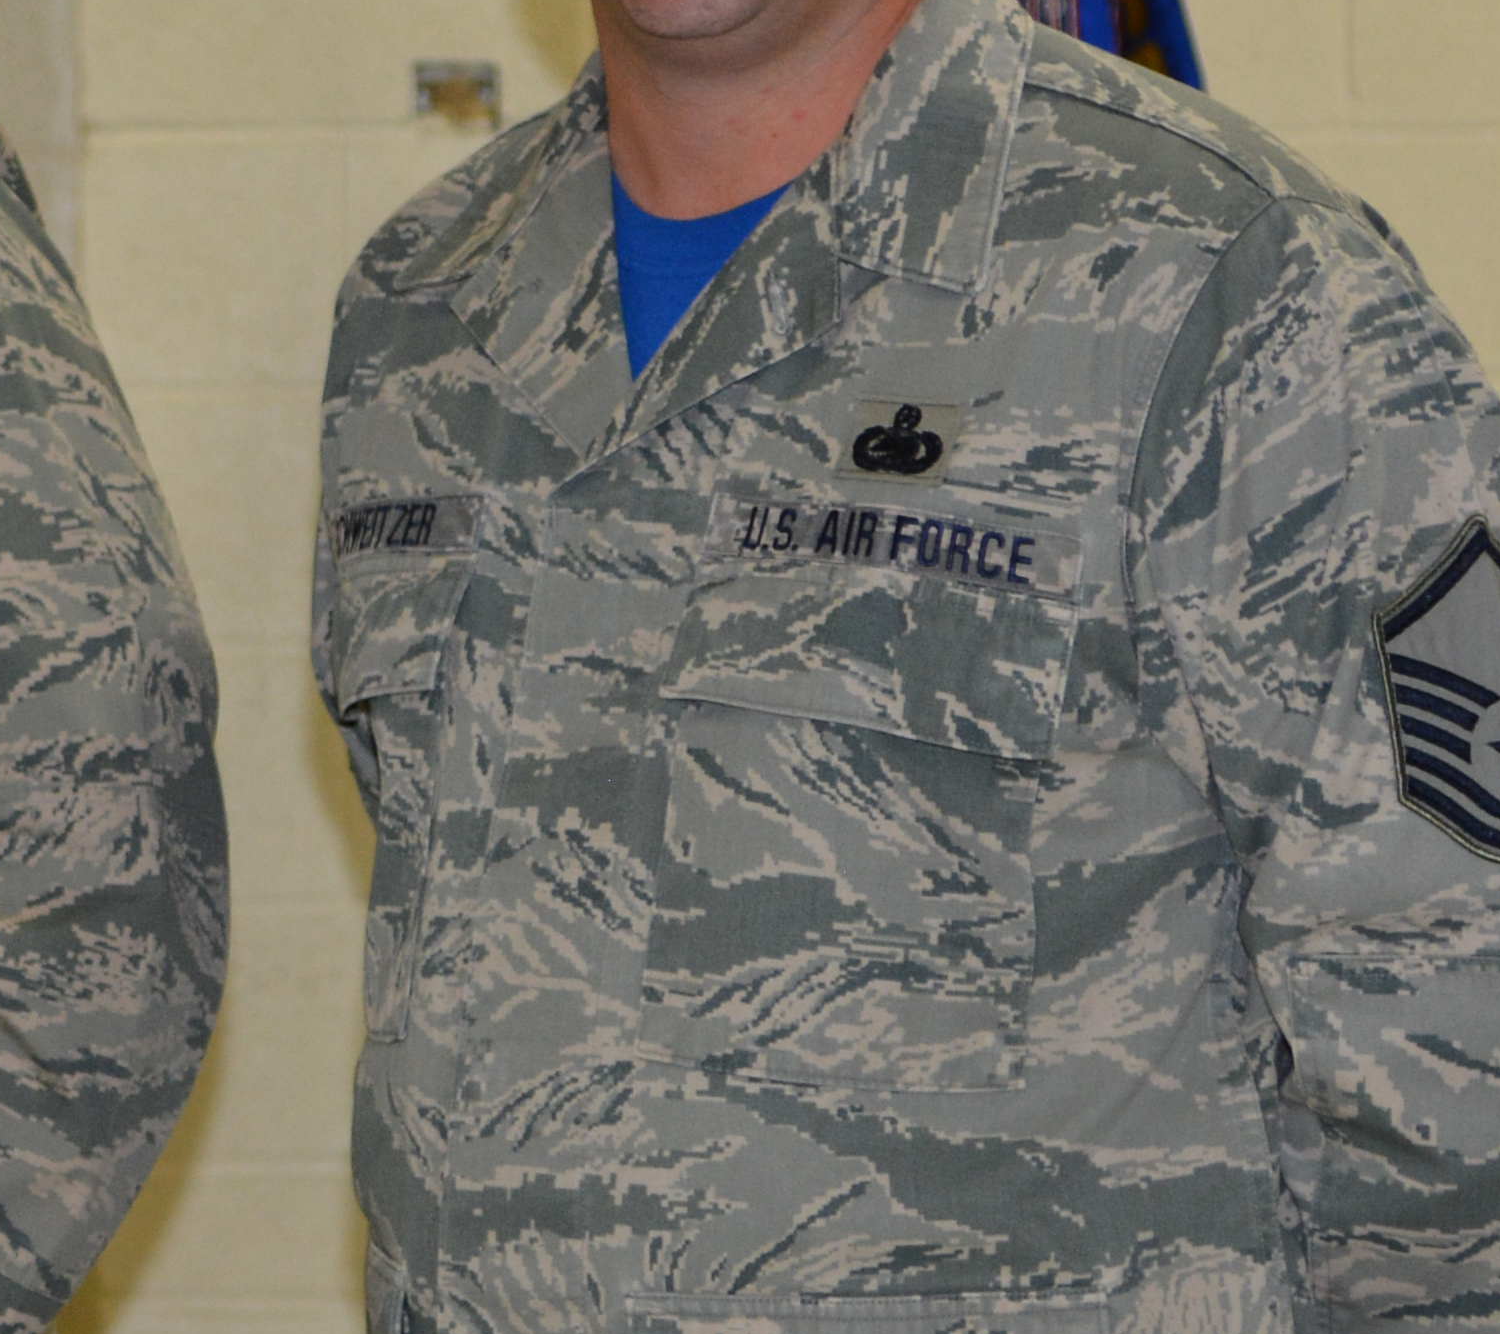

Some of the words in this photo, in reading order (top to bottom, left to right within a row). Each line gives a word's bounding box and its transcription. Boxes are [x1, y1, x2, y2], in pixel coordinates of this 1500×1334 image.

[742, 505, 799, 552] U.S.
[814, 509, 878, 558] AIR
[890, 514, 1036, 584] FORCE
